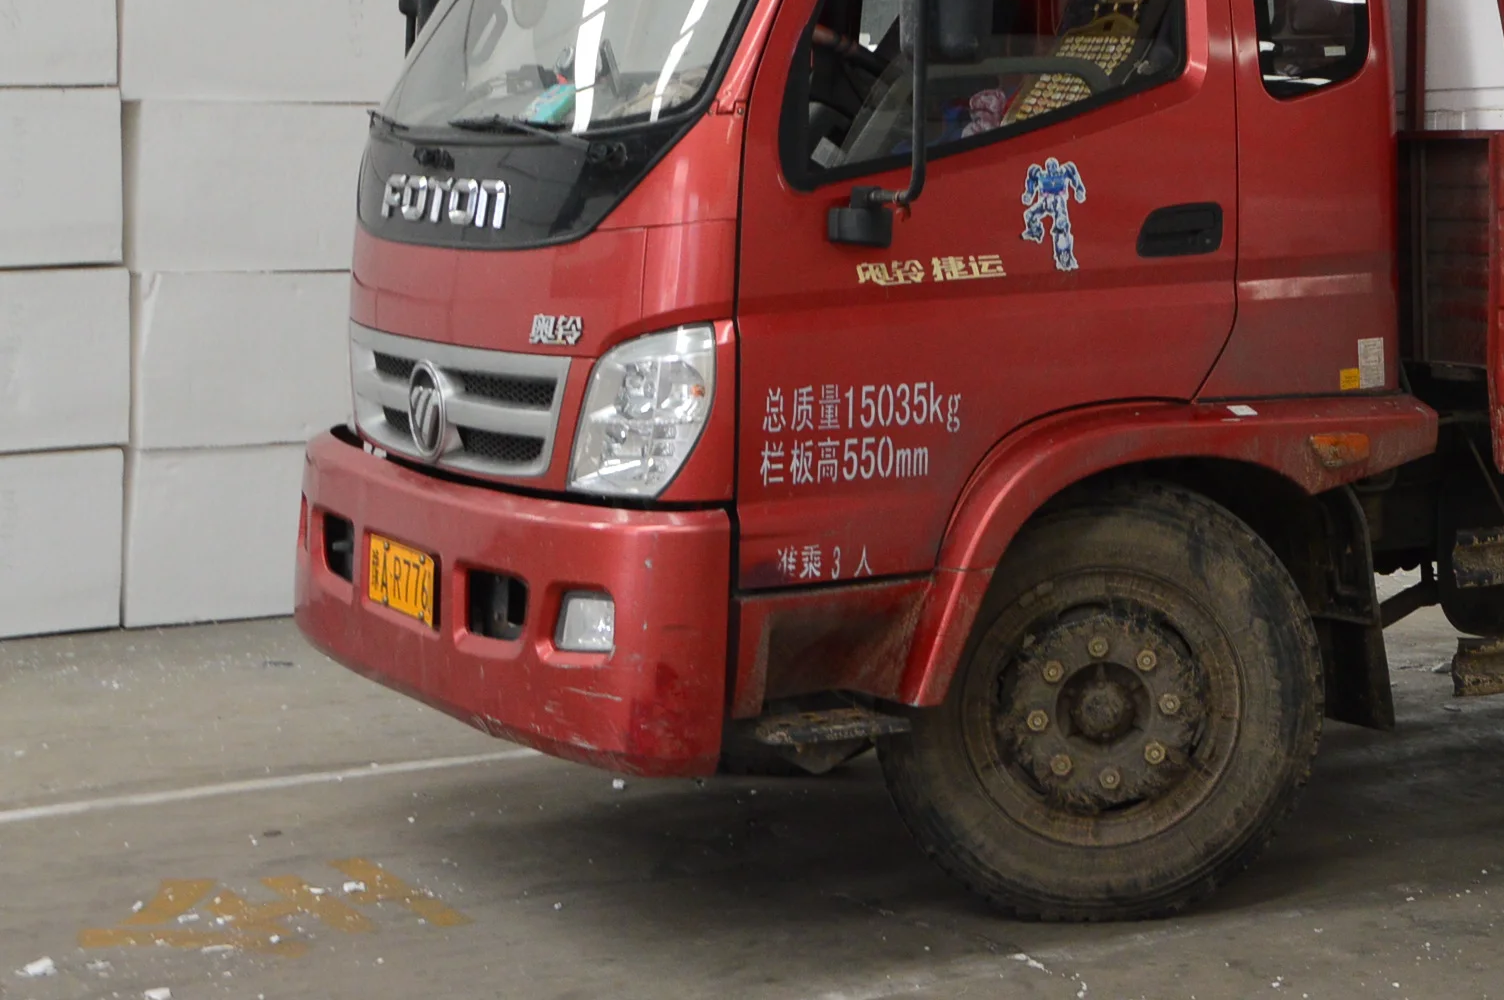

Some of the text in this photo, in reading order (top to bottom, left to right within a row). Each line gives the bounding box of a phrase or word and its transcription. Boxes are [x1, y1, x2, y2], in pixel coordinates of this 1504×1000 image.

[381, 174, 506, 229] FOTON
[762, 381, 961, 432] 总质量15035kg
[760, 435, 929, 487] 栏板高550mm
